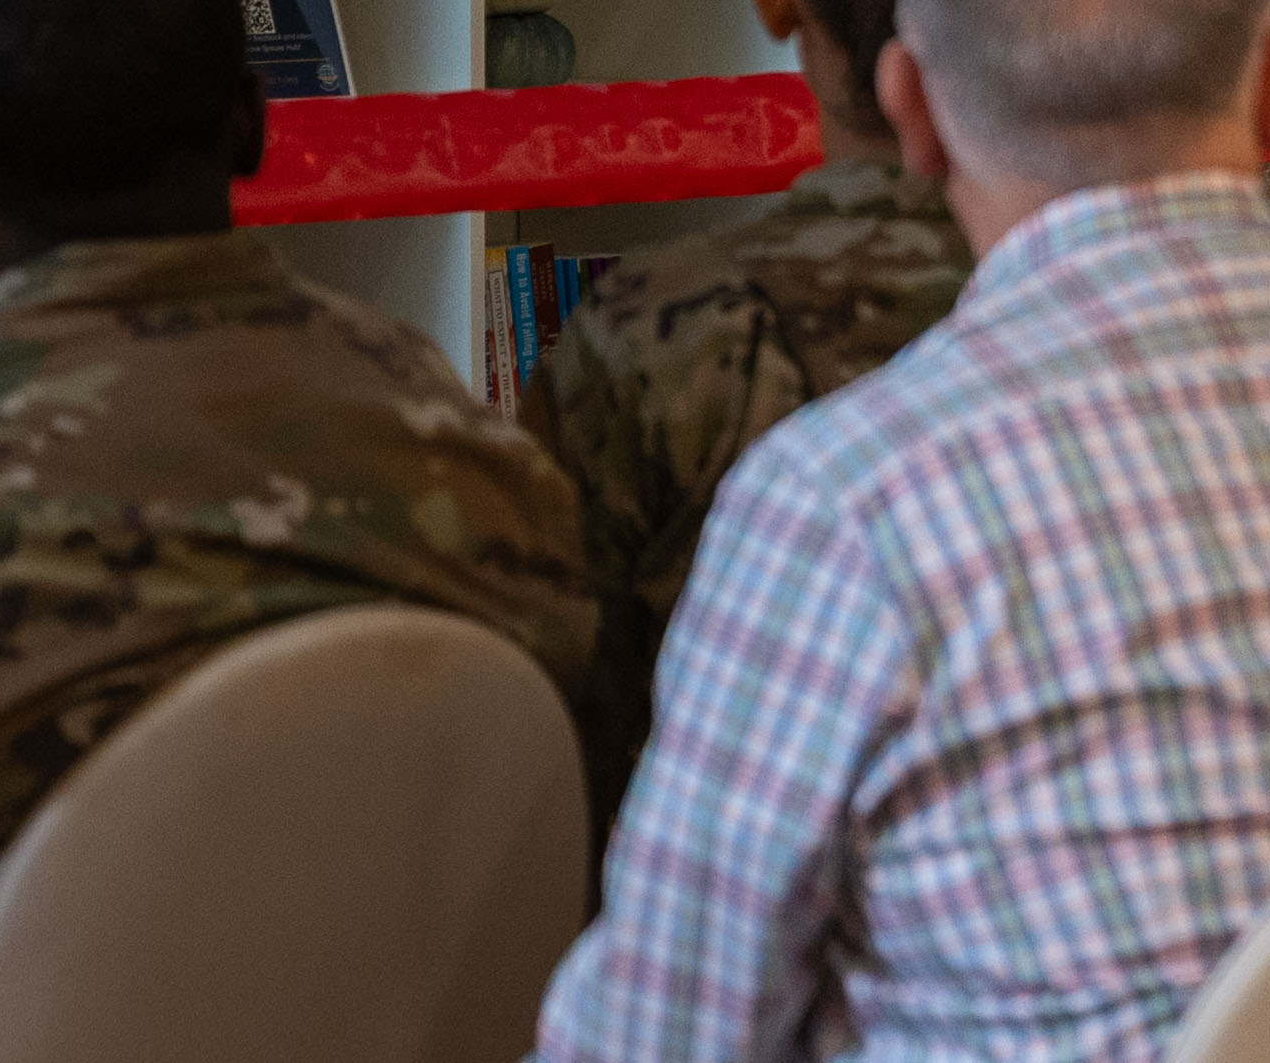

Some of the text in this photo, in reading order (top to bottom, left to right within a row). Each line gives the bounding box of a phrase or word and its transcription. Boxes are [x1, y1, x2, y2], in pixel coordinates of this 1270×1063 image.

[516, 253, 527, 274] How
[520, 291, 532, 319] Avoid
[521, 322, 535, 356] Falling
